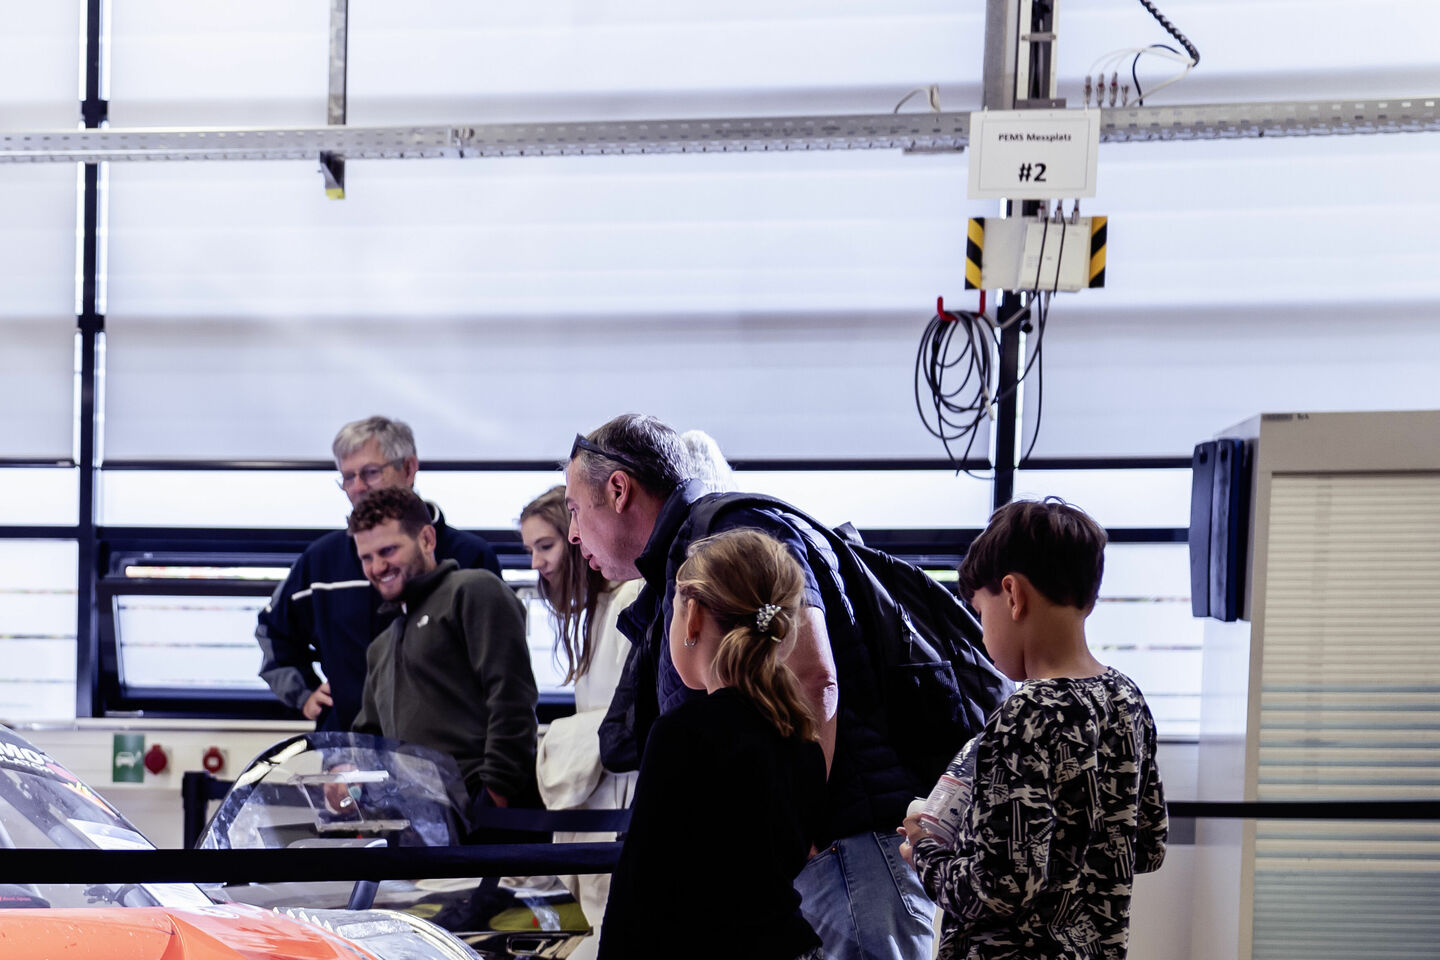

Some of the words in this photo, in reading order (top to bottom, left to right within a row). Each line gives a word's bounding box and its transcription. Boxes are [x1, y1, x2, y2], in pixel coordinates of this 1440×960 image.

[998, 133, 1024, 141] PEMS
[1026, 133, 1071, 143] Messplatz
[1019, 163, 1047, 182] #2
